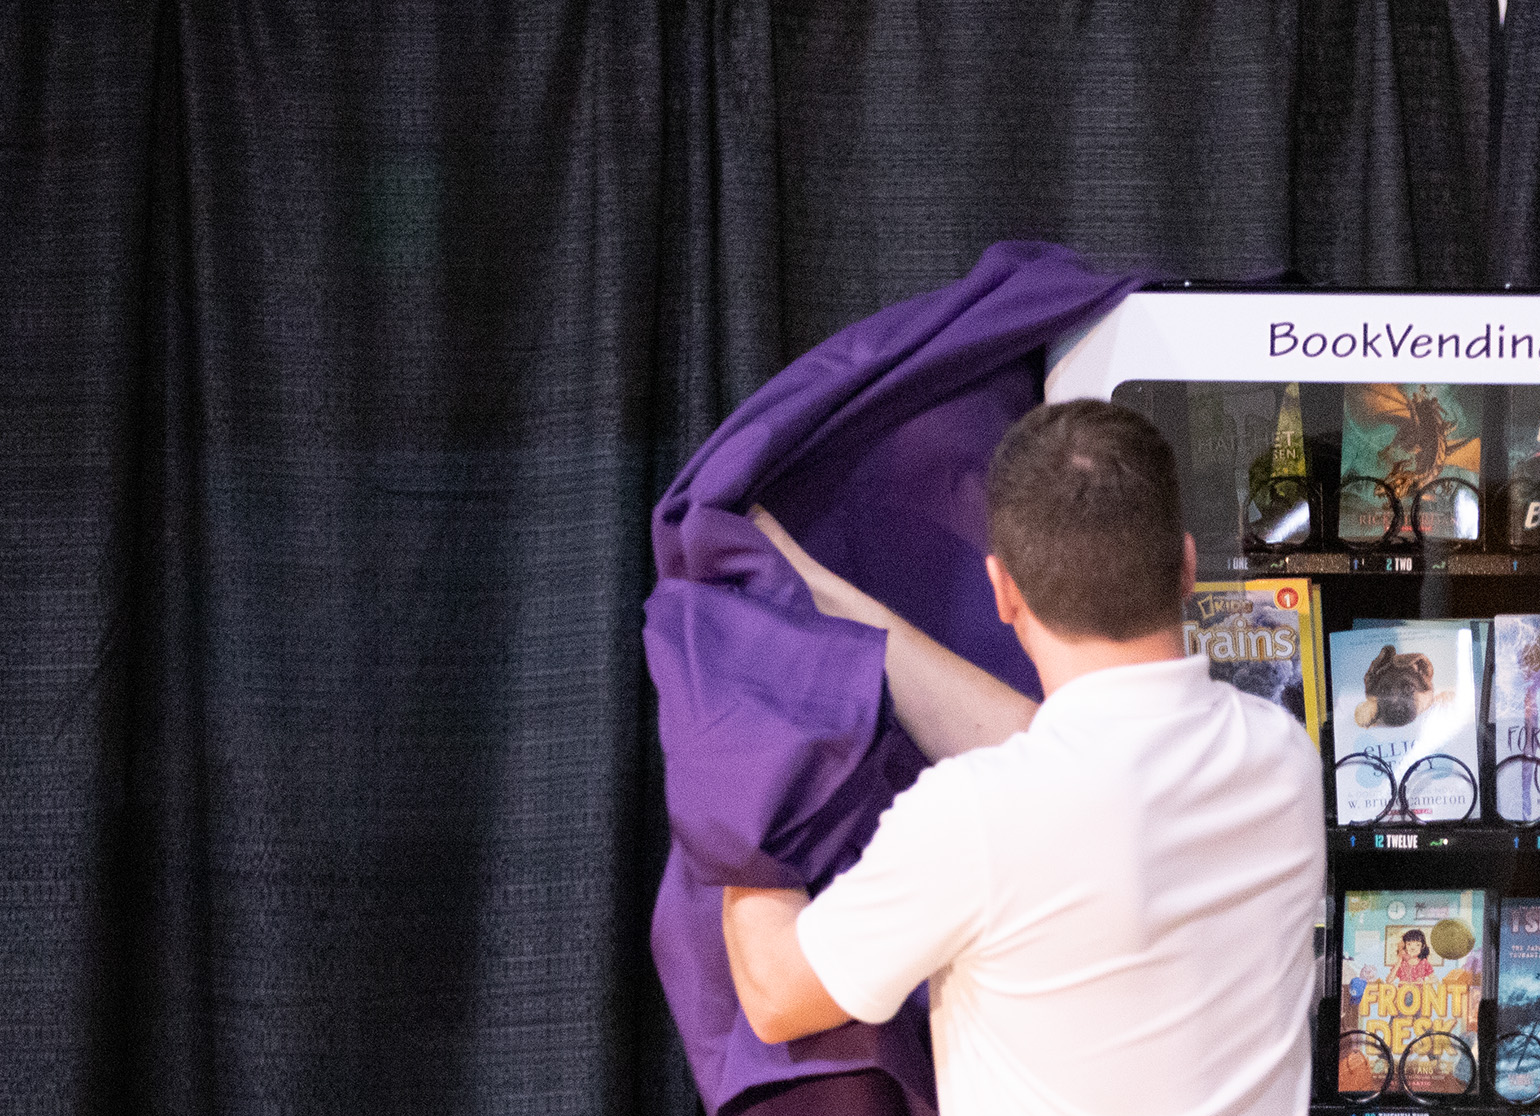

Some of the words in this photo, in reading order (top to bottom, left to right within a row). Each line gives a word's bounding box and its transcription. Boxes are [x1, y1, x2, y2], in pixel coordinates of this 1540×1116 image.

[1386, 558, 1393, 570] 2
[1395, 557, 1413, 571] TWO
[1284, 593, 1291, 607] 1
[1183, 618, 1295, 660] Trains
[1375, 835, 1384, 848] 12
[1386, 835, 1418, 848] TWELVE
[1512, 911, 1520, 932] I
[1360, 982, 1468, 1018] FRONT
[1365, 1014, 1462, 1057] DESK
